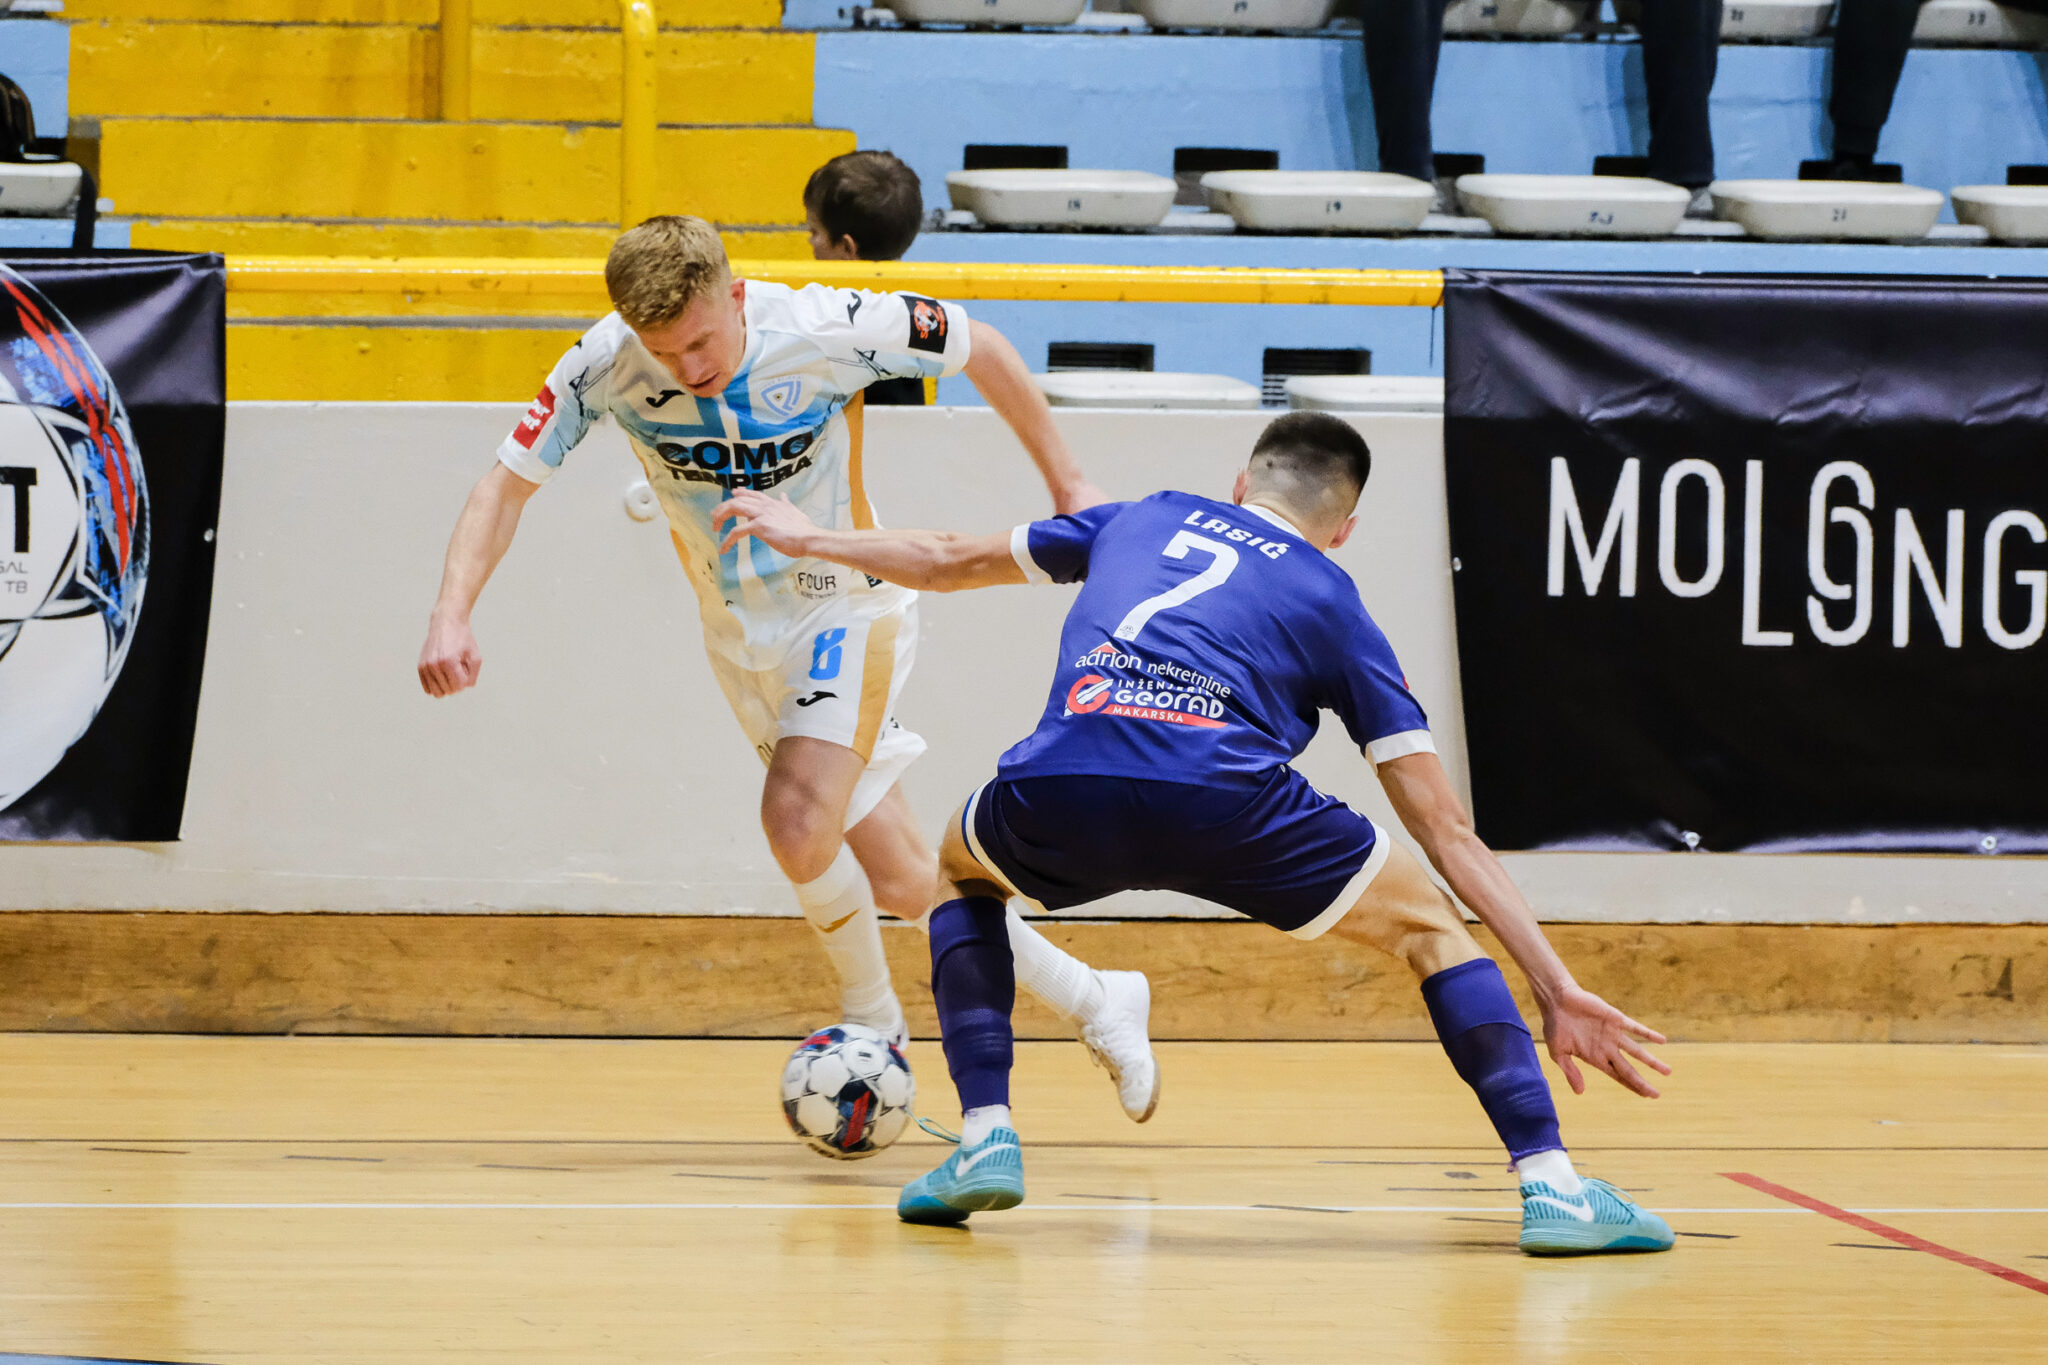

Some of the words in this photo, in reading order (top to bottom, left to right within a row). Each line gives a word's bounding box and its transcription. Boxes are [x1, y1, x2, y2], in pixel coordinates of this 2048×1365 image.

[656, 432, 813, 470] COMO
[1183, 510, 1291, 559] LASIĆ
[5, 580, 28, 594] TB
[798, 572, 837, 590] FOUR
[1113, 530, 1240, 642] 7
[809, 627, 848, 680] 8
[1075, 650, 1142, 669] adrion
[1147, 661, 1231, 698] nekretnine
[1112, 706, 1184, 723] MAKARSKA
